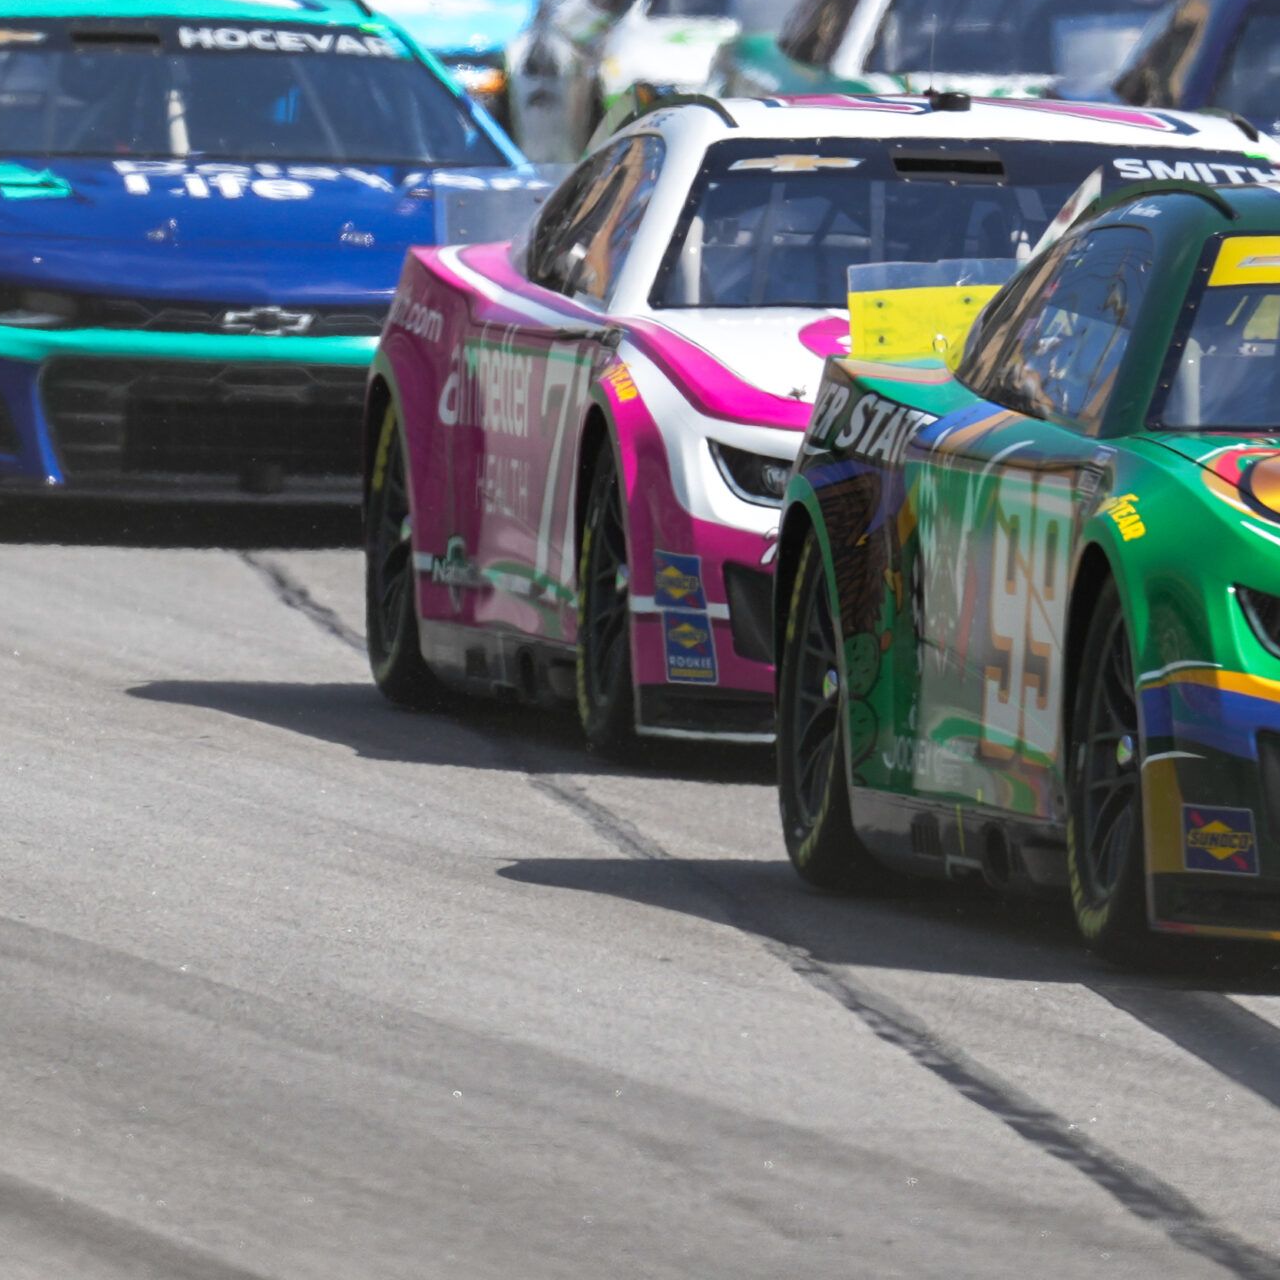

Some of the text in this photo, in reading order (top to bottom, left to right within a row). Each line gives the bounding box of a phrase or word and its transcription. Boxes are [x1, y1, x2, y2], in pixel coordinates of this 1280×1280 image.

[178, 26, 410, 60] HOCEVAR
[669, 655, 713, 669] ROOKIE
[1187, 828, 1255, 852] SUNOCO
